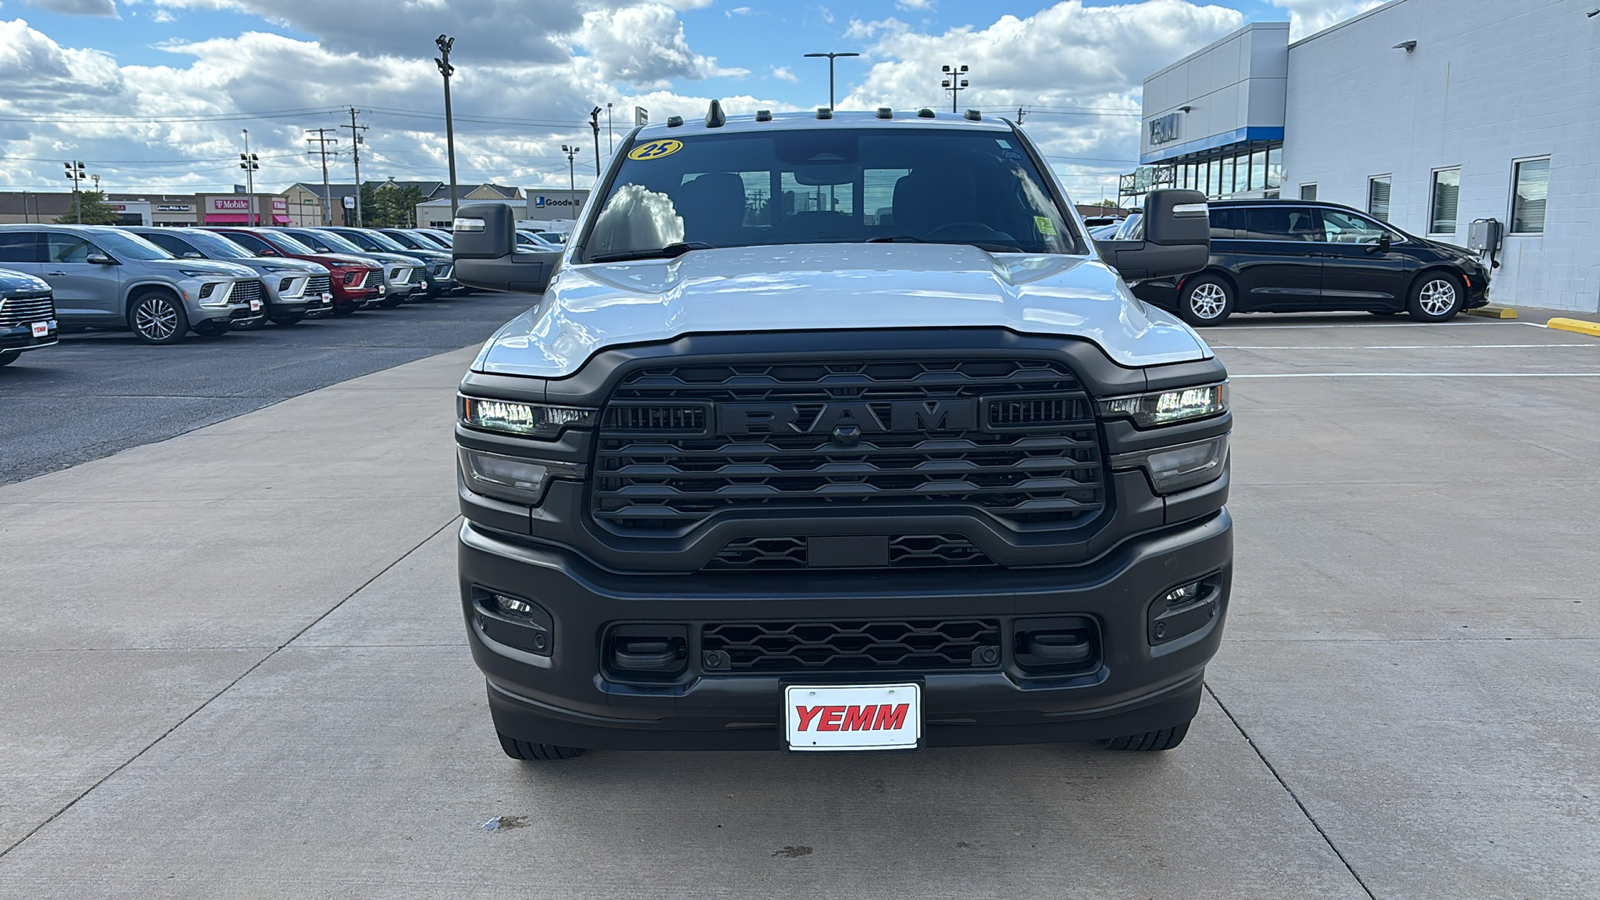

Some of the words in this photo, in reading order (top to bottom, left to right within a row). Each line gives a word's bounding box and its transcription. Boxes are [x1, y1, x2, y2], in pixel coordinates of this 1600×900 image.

[637, 141, 673, 158] 25
[719, 400, 976, 434] RAM
[795, 703, 910, 732] YEMM
